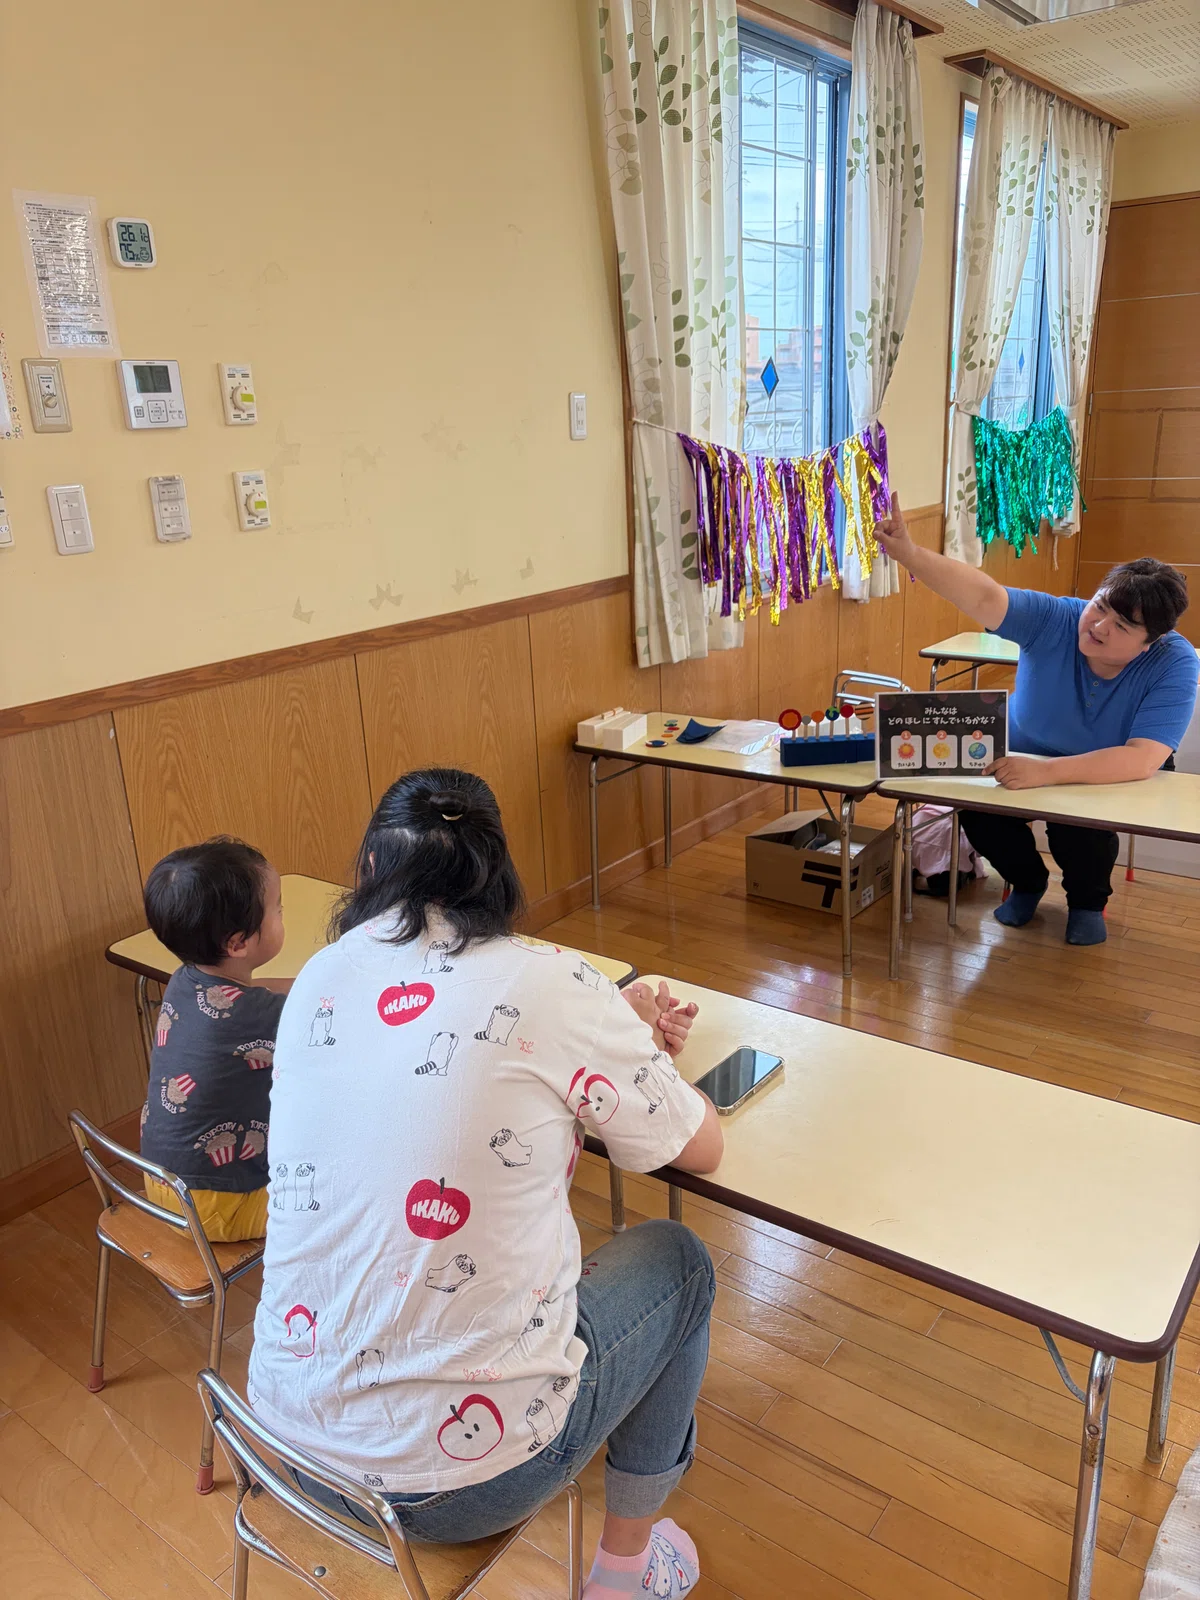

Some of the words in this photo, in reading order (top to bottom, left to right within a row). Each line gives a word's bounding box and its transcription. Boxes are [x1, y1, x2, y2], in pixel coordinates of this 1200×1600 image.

[924, 706, 958, 715] みんなは
[383, 994, 428, 1015] IKAKU
[411, 1199, 461, 1225] IKAKU
